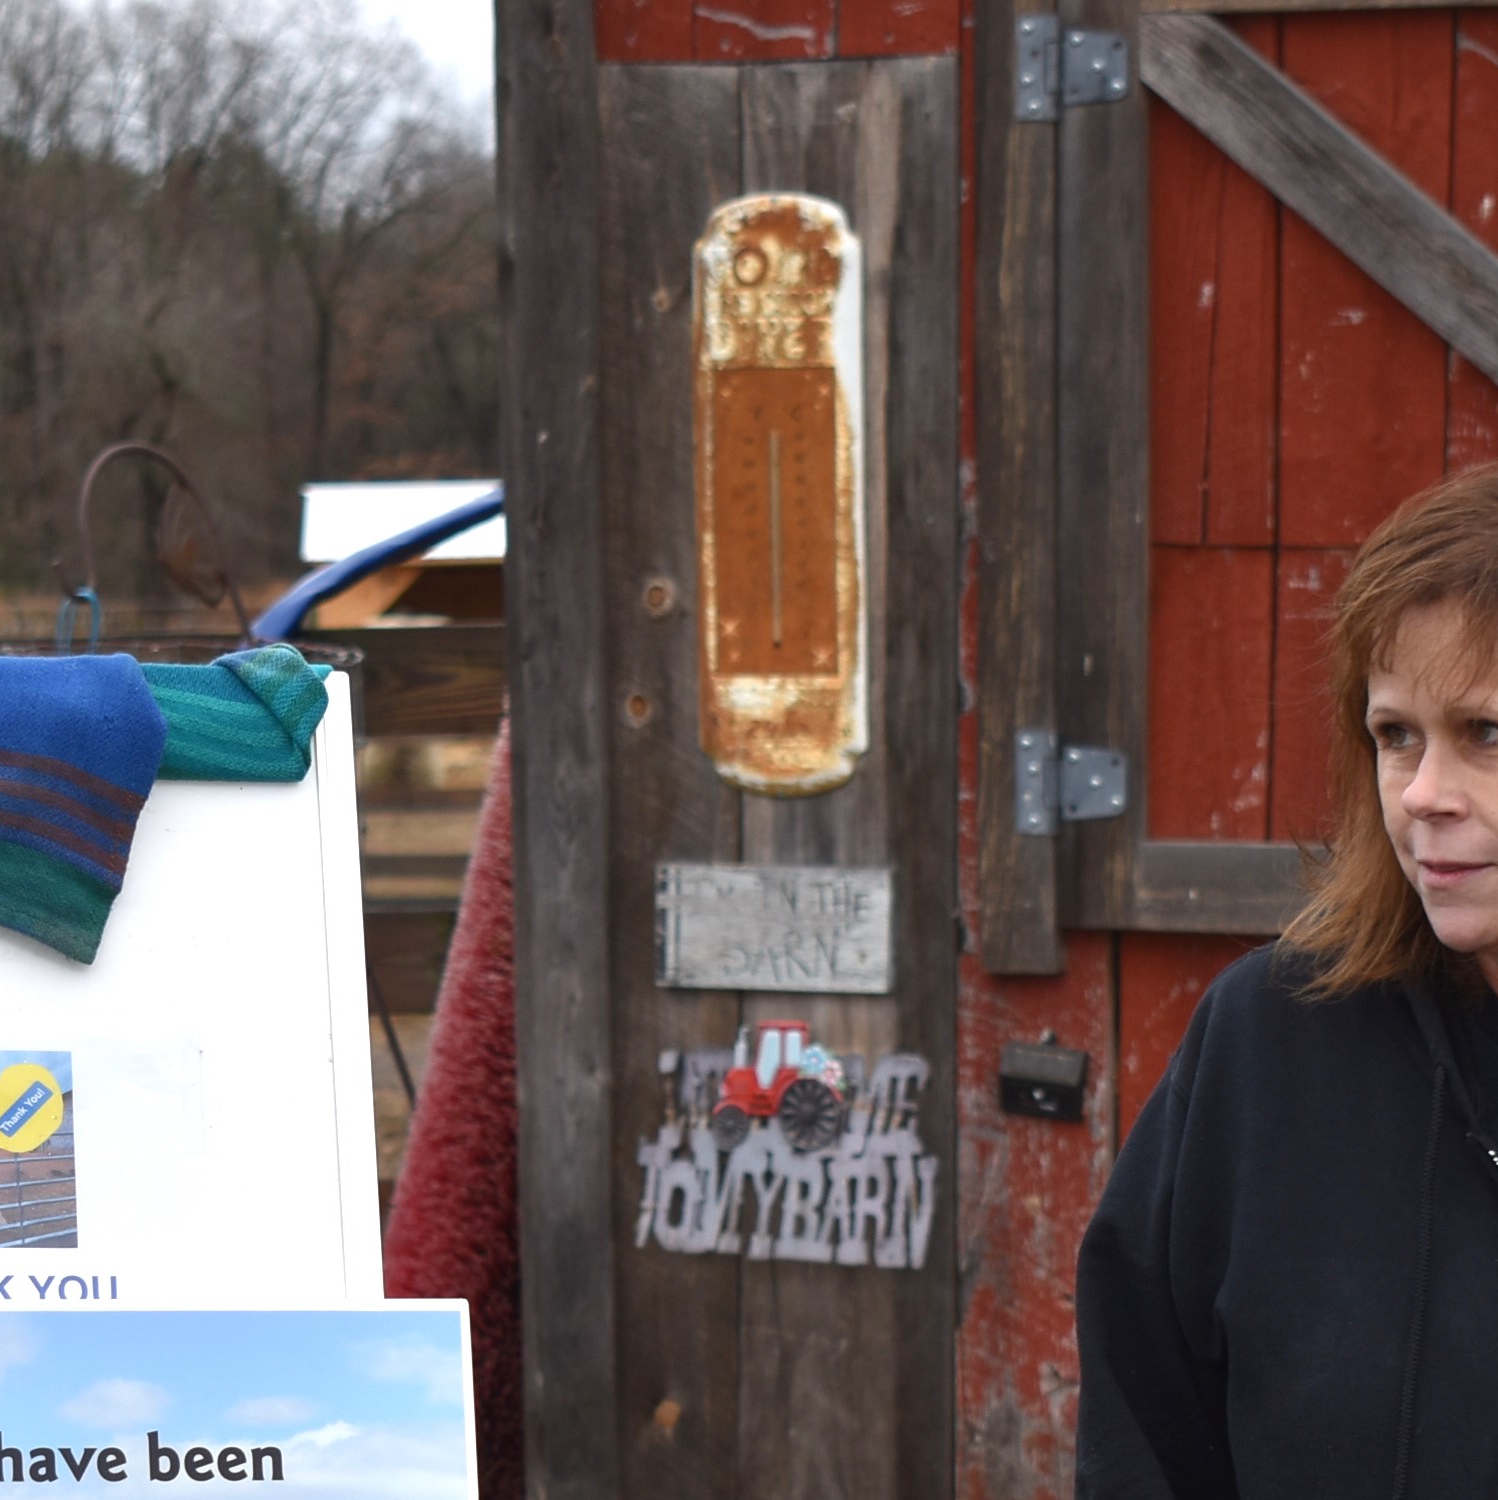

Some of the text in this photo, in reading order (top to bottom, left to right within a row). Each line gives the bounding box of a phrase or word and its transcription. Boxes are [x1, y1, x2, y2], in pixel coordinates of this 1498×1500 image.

[0, 1088, 45, 1131] Thank You!
[28, 1275, 118, 1300] YOU
[148, 1431, 283, 1481] been
